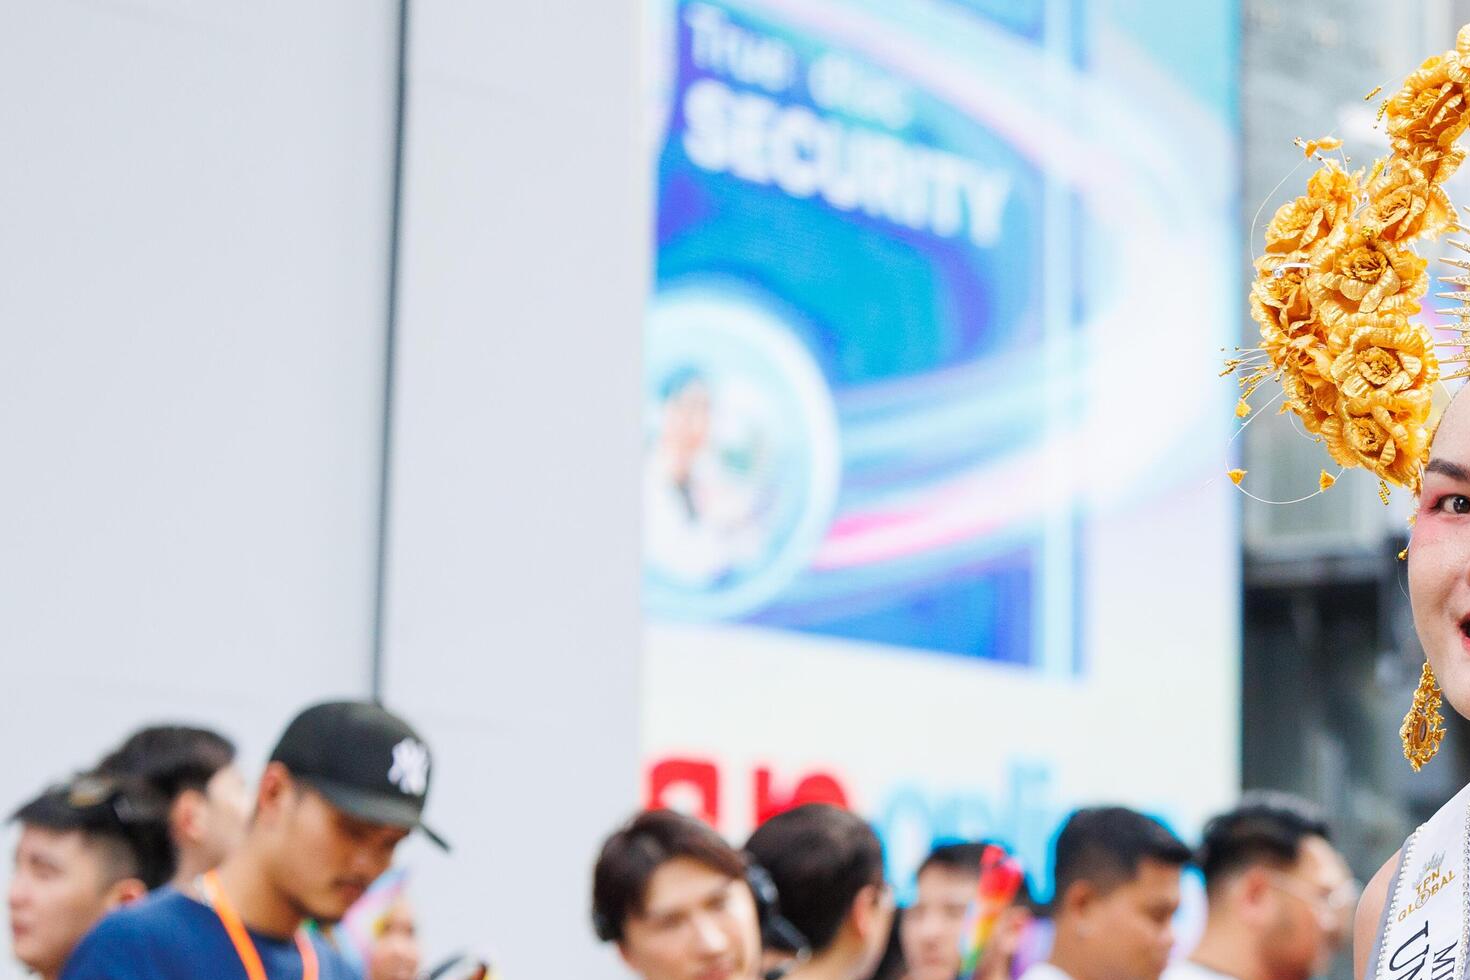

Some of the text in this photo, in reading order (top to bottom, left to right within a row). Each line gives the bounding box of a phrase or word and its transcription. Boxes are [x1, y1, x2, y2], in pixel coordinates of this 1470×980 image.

[683, 77, 1011, 249] SECURITY
[1398, 870, 1455, 922] GLOBAL
[1416, 866, 1440, 895] TPN
